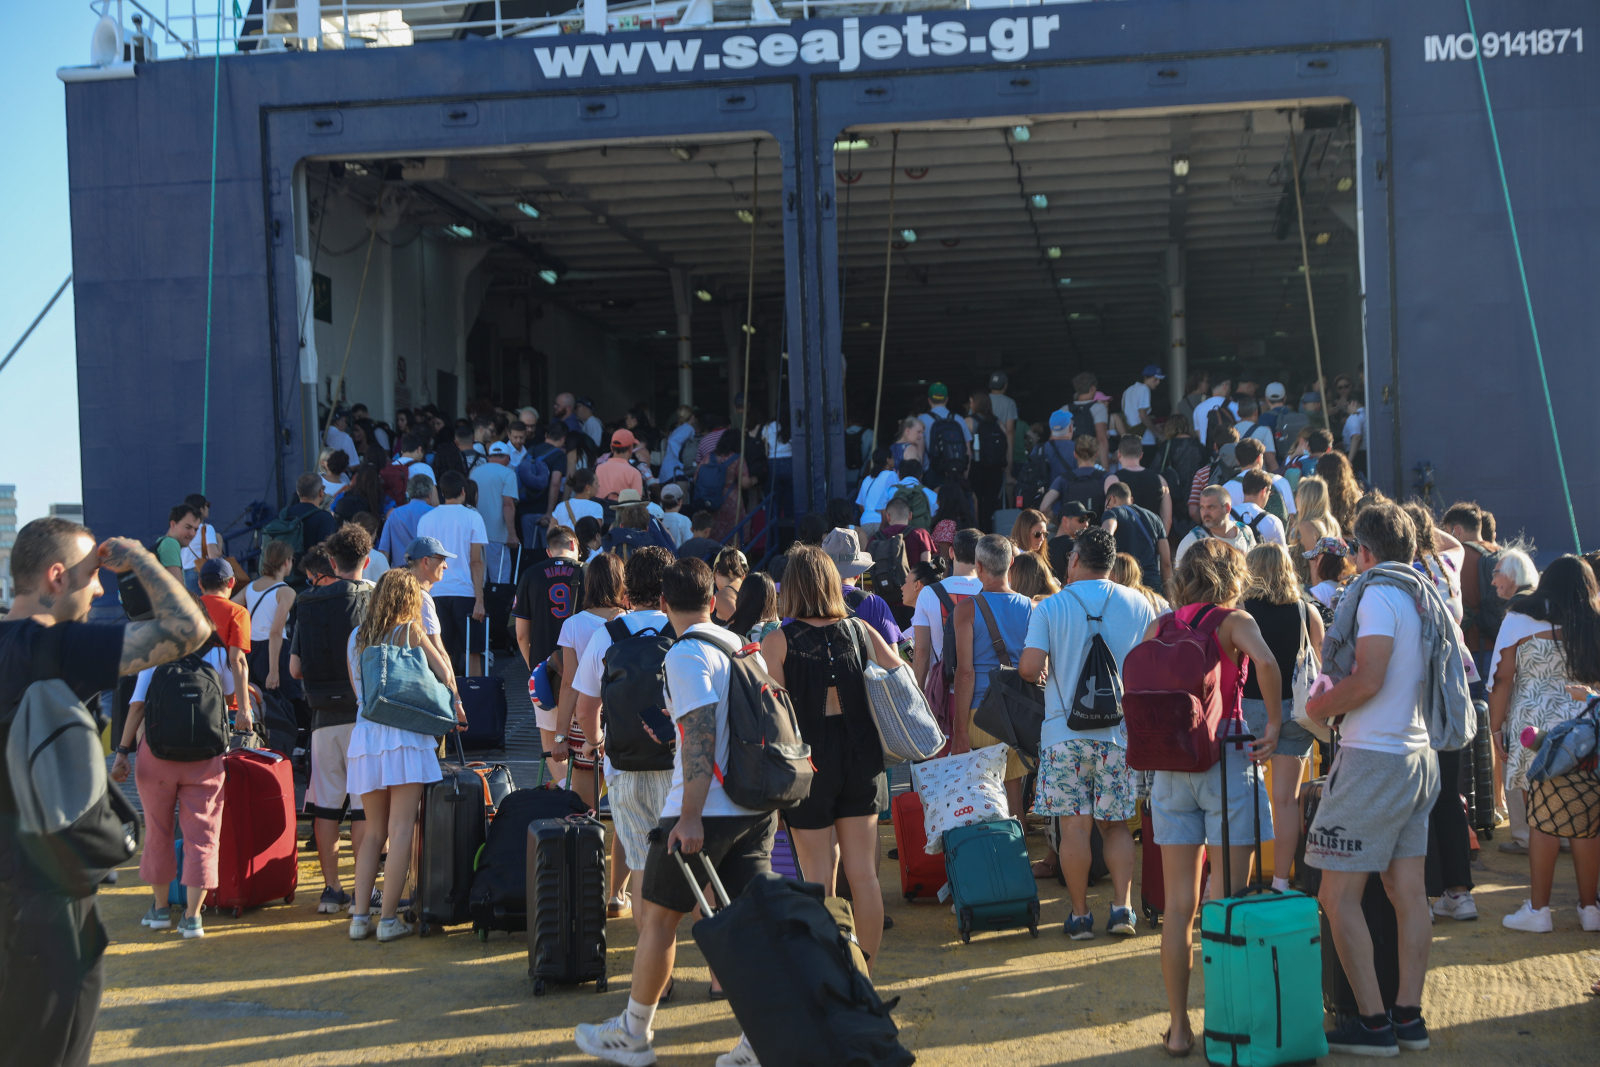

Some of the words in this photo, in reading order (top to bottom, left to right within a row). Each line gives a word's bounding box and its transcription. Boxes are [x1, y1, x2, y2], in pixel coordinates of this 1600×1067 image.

[533, 14, 1060, 79] www.seajets.gr
[1424, 32, 1479, 62] IMO
[1481, 27, 1583, 58] 9141871
[544, 565, 574, 579] NIMMO
[548, 582, 571, 618] 9
[1072, 708, 1101, 720] UNDER
[954, 805, 974, 817] coop
[1308, 832, 1362, 852] OLLISTER
